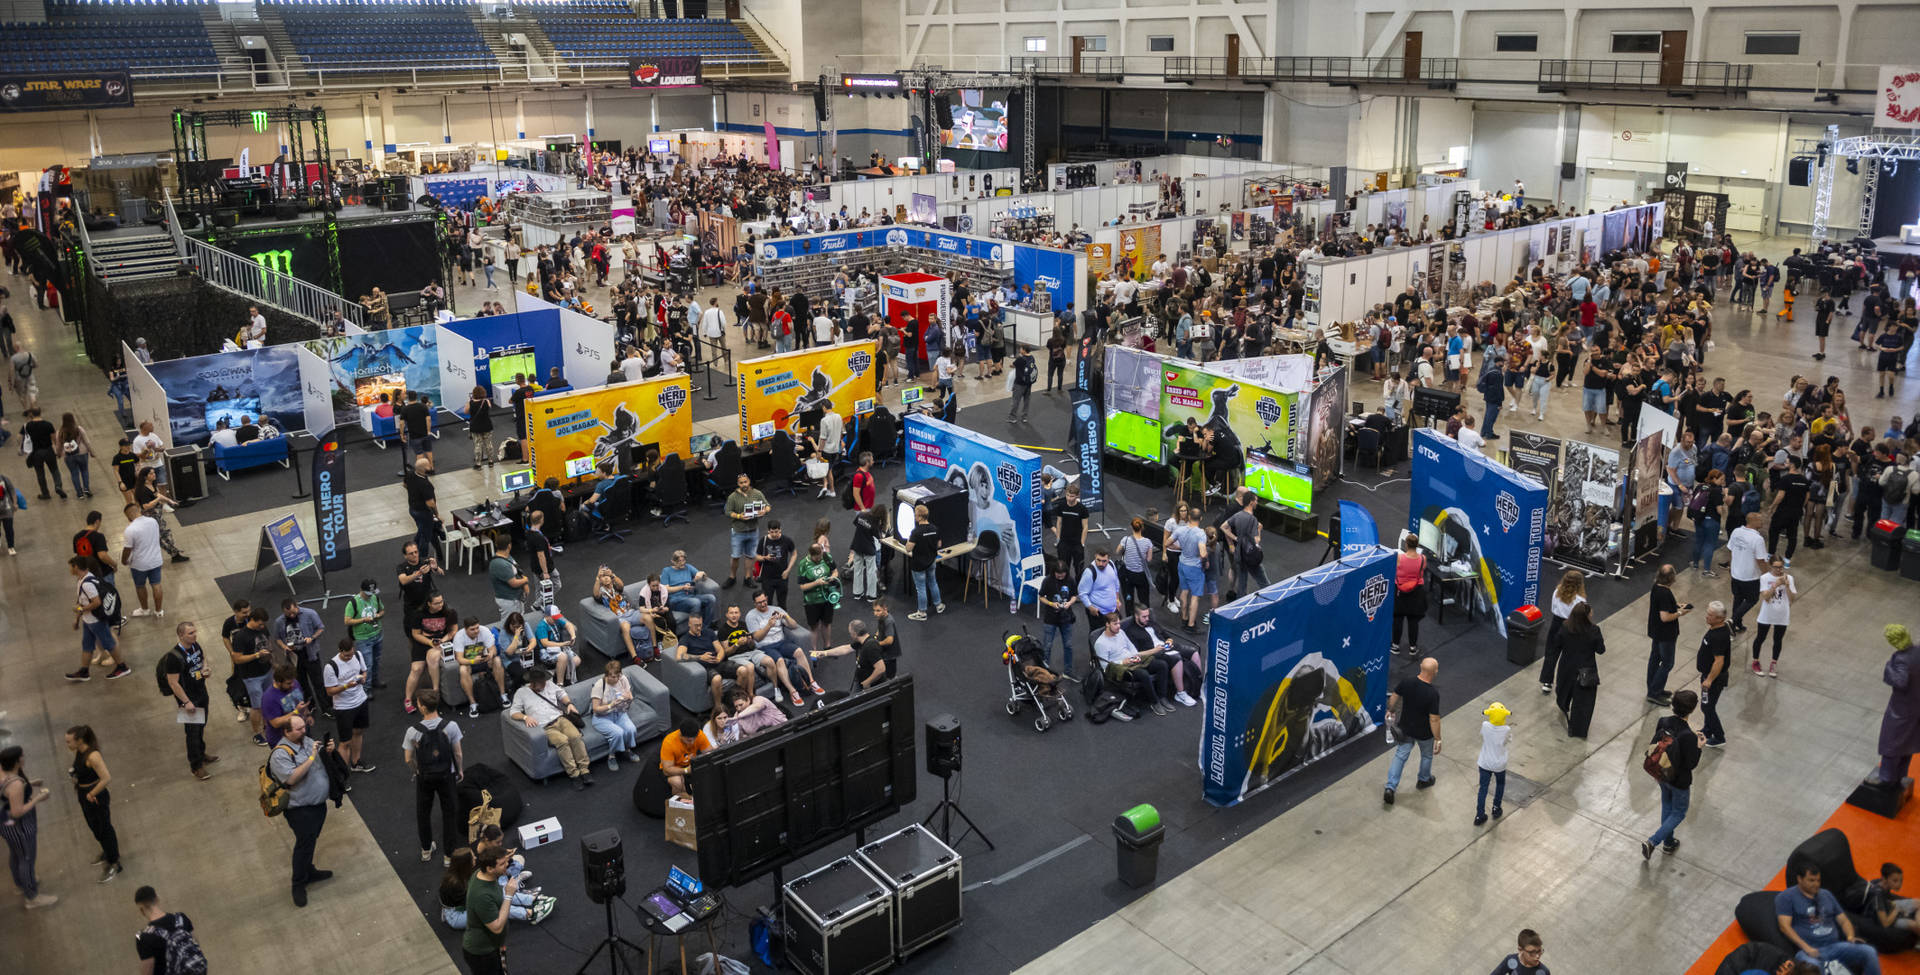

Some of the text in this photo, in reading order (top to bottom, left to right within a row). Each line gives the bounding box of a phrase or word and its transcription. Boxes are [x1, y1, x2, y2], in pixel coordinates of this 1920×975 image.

[23, 79, 102, 91] STAR WARS
[660, 76, 696, 85] LOUNGE
[821, 238, 846, 250] Funko
[938, 237, 958, 251] Funko
[584, 347, 600, 360] PS5
[848, 355, 871, 366] HERO
[850, 364, 869, 373] TOUR
[658, 390, 686, 402] HERO
[660, 400, 685, 410] TOUR
[1256, 400, 1281, 416] HERO
[1257, 411, 1279, 423] TOUR
[1287, 404, 1296, 435] TOUR
[908, 426, 936, 442] SAMSUNG
[1423, 446, 1440, 463] TDK
[997, 467, 1022, 486] HERO
[320, 471, 332, 511] HERO
[999, 479, 1021, 493] TOUR
[1031, 468, 1041, 508] TOUR
[333, 494, 345, 533] TOUR
[1496, 495, 1519, 517] HERO
[1498, 508, 1518, 526] TOUR
[1031, 509, 1041, 546] HERO
[1529, 507, 1544, 545] TOUR
[322, 513, 336, 560] LOCAL
[1525, 546, 1540, 582] HERO
[1360, 580, 1388, 602] HERO
[1361, 594, 1386, 611] TOUR
[1250, 618, 1276, 639] TDK
[1211, 639, 1230, 786] LOCAL HERO TOUR
